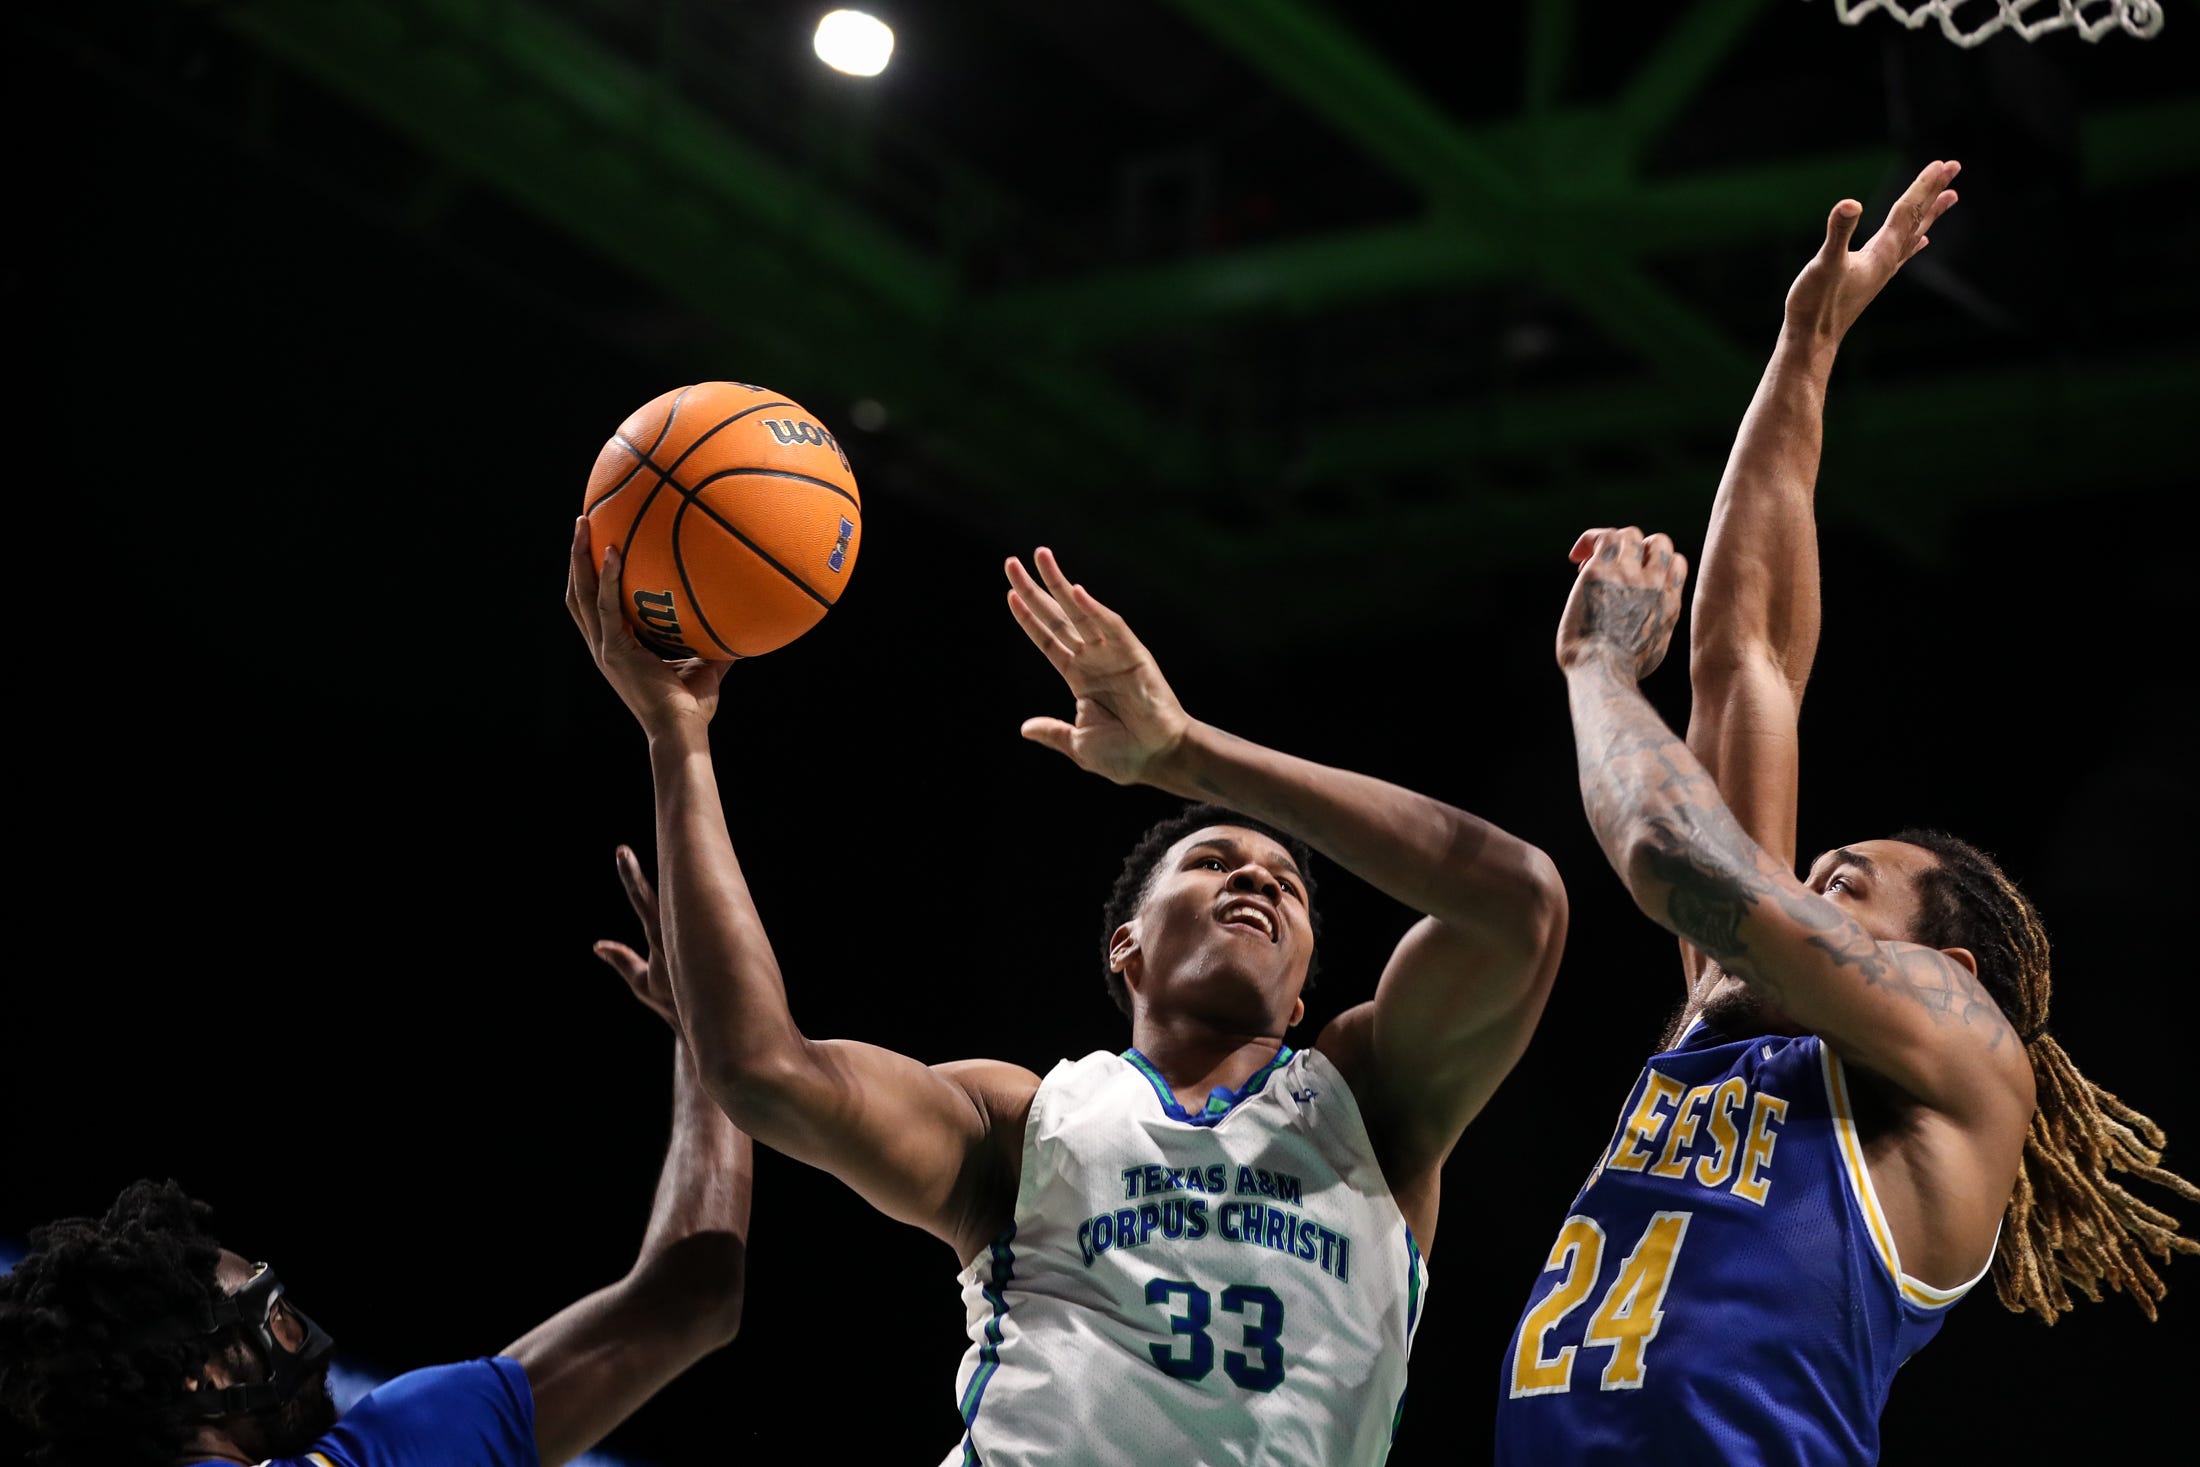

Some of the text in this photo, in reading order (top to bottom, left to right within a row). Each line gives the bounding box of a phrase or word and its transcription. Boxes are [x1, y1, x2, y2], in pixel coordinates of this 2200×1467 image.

[1122, 1163, 1304, 1208] TEXAS A&M
[1587, 1067, 1790, 1207] EESE
[1077, 1199, 1351, 1284] CORPUS CHRISTI
[1145, 1277, 1286, 1393] 33
[1509, 1210, 1693, 1400] 24
